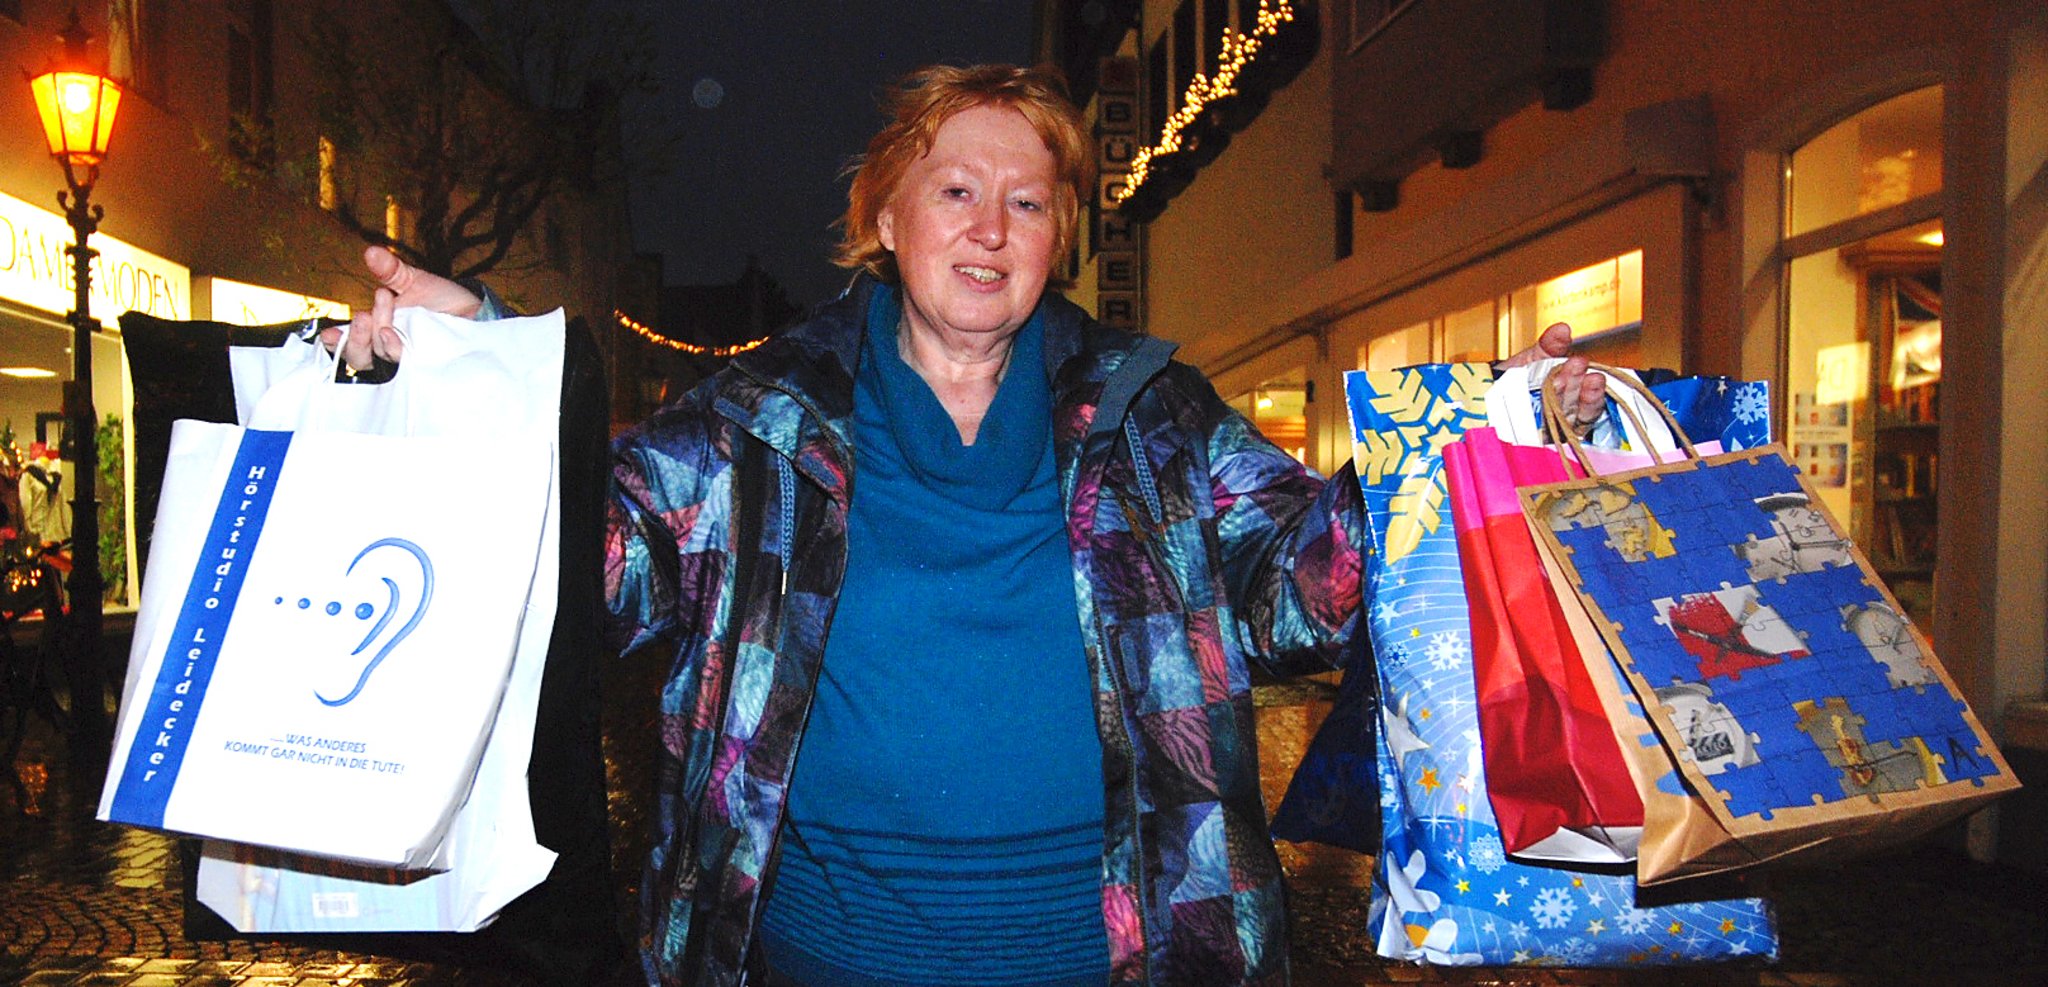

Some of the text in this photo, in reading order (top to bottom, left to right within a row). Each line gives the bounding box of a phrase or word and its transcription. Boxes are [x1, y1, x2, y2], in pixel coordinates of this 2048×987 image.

[1104, 101, 1132, 319] BÜCHER
[0, 215, 180, 321] DAME MODEN
[143, 465, 267, 782] Hörstudio Leidecker
[224, 740, 269, 756] KOMMT
[270, 747, 296, 760] GAR
[297, 751, 334, 765] NICHT
[335, 756, 348, 767] IN
[349, 758, 370, 770] DIE
[313, 738, 367, 753] ANDERES
